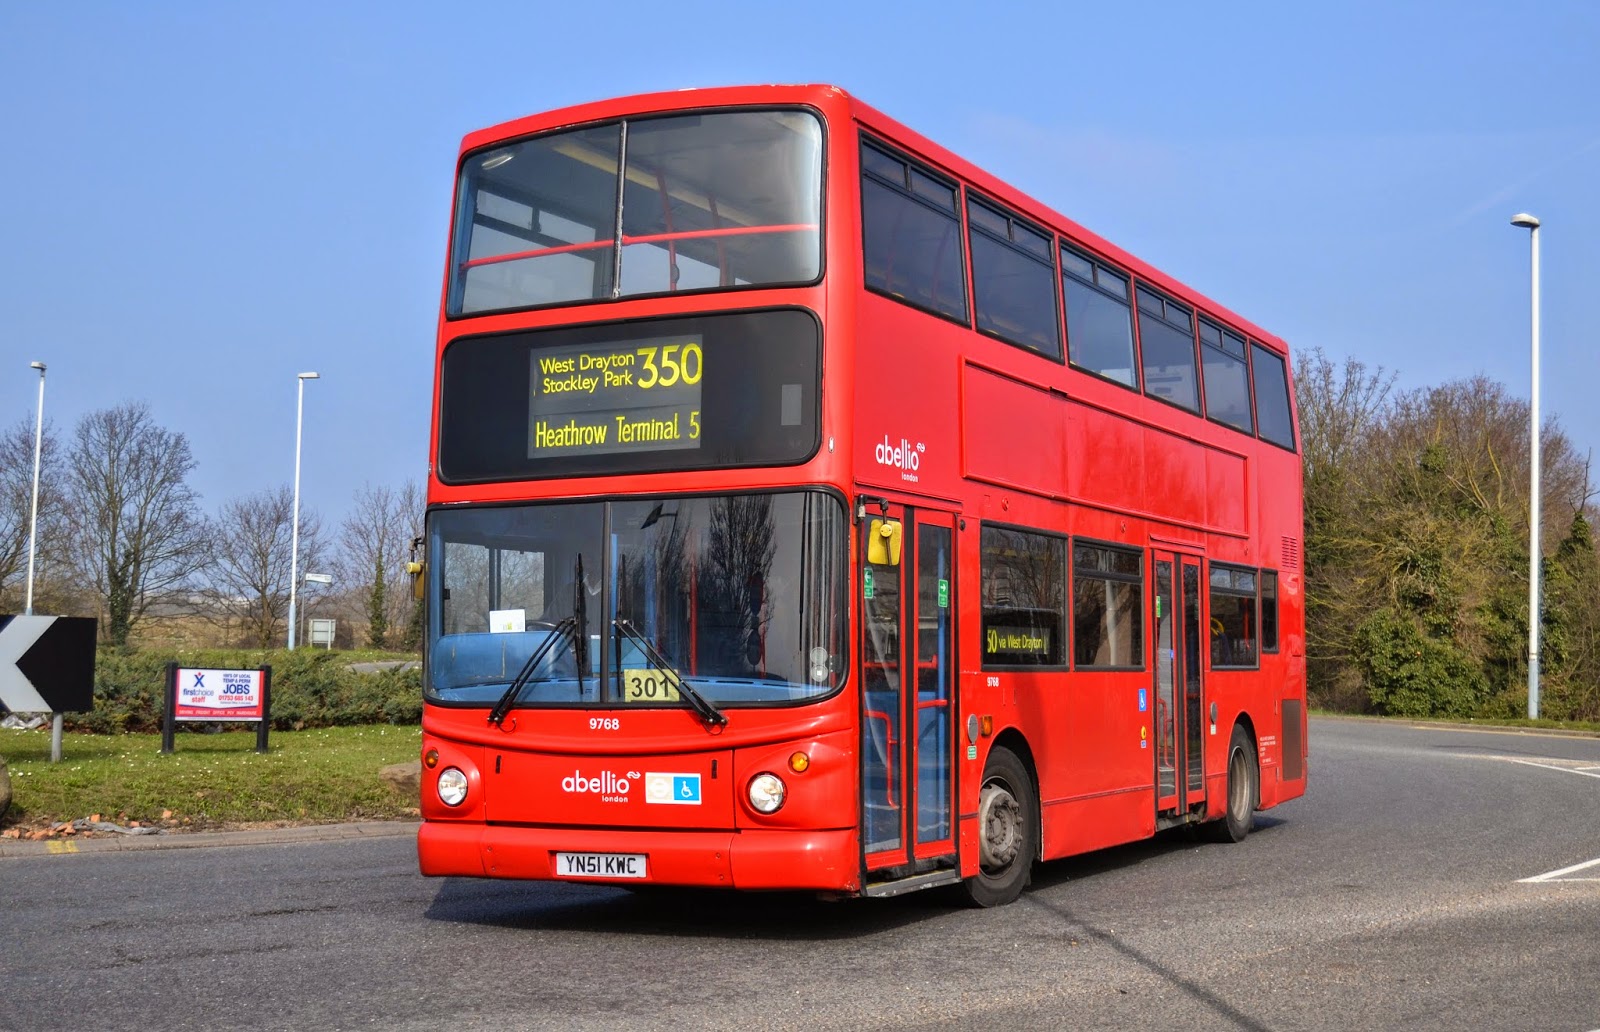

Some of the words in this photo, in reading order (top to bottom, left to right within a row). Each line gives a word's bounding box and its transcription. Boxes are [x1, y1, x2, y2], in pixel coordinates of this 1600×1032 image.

[540, 358, 575, 374] West
[580, 354, 634, 373] Drayton
[637, 343, 703, 389] 350
[543, 375, 599, 394] Stockley
[604, 370, 633, 387] Park
[536, 420, 607, 448] Heathrow
[616, 413, 680, 443] Terminal
[689, 411, 700, 439] 5
[876, 434, 919, 471] abellio
[901, 471, 919, 482] london
[1008, 634, 1021, 649] West
[1022, 635, 1042, 652] Drayton
[223, 684, 250, 694] JOBS
[631, 677, 669, 698] 301
[987, 676, 999, 687] 9768
[183, 688, 214, 696] firstchoice
[589, 718, 620, 730] 9768
[562, 769, 630, 794] abellio
[601, 795, 628, 803] london
[566, 856, 600, 873] YN51
[605, 857, 637, 874] KWC
